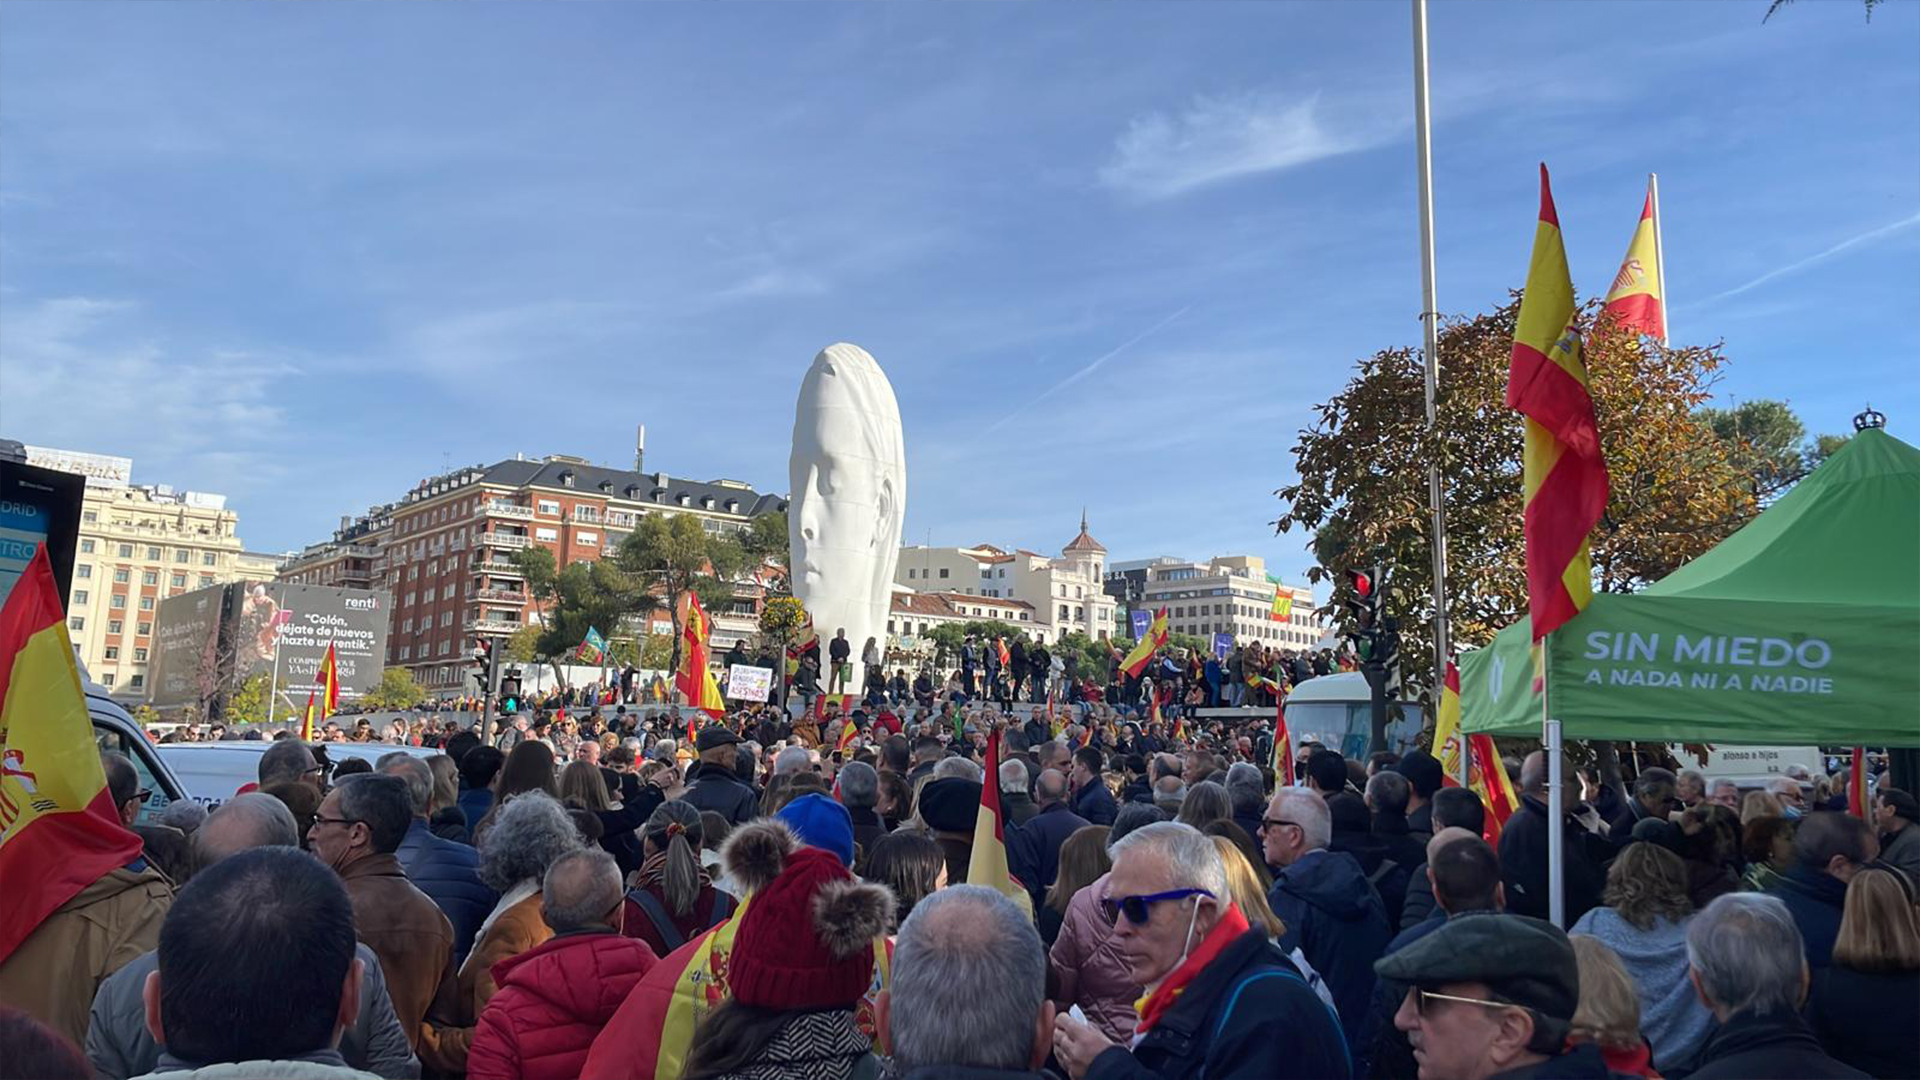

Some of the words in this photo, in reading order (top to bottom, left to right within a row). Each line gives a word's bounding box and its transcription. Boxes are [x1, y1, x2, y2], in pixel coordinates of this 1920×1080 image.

[275, 623, 314, 636] déjate
[316, 625, 331, 636] de
[333, 627, 374, 639] huevos
[281, 634, 315, 646] hazte
[1583, 631, 1659, 662] SIN
[1673, 633, 1831, 669] MIEDO
[1584, 669, 1602, 685] A
[1609, 669, 1683, 688] NADA
[1691, 672, 1719, 690] NI
[1722, 673, 1743, 691] A
[1750, 674, 1833, 694] NADIE
[1722, 750, 1750, 760] alonso
[1758, 750, 1779, 761] hijos
